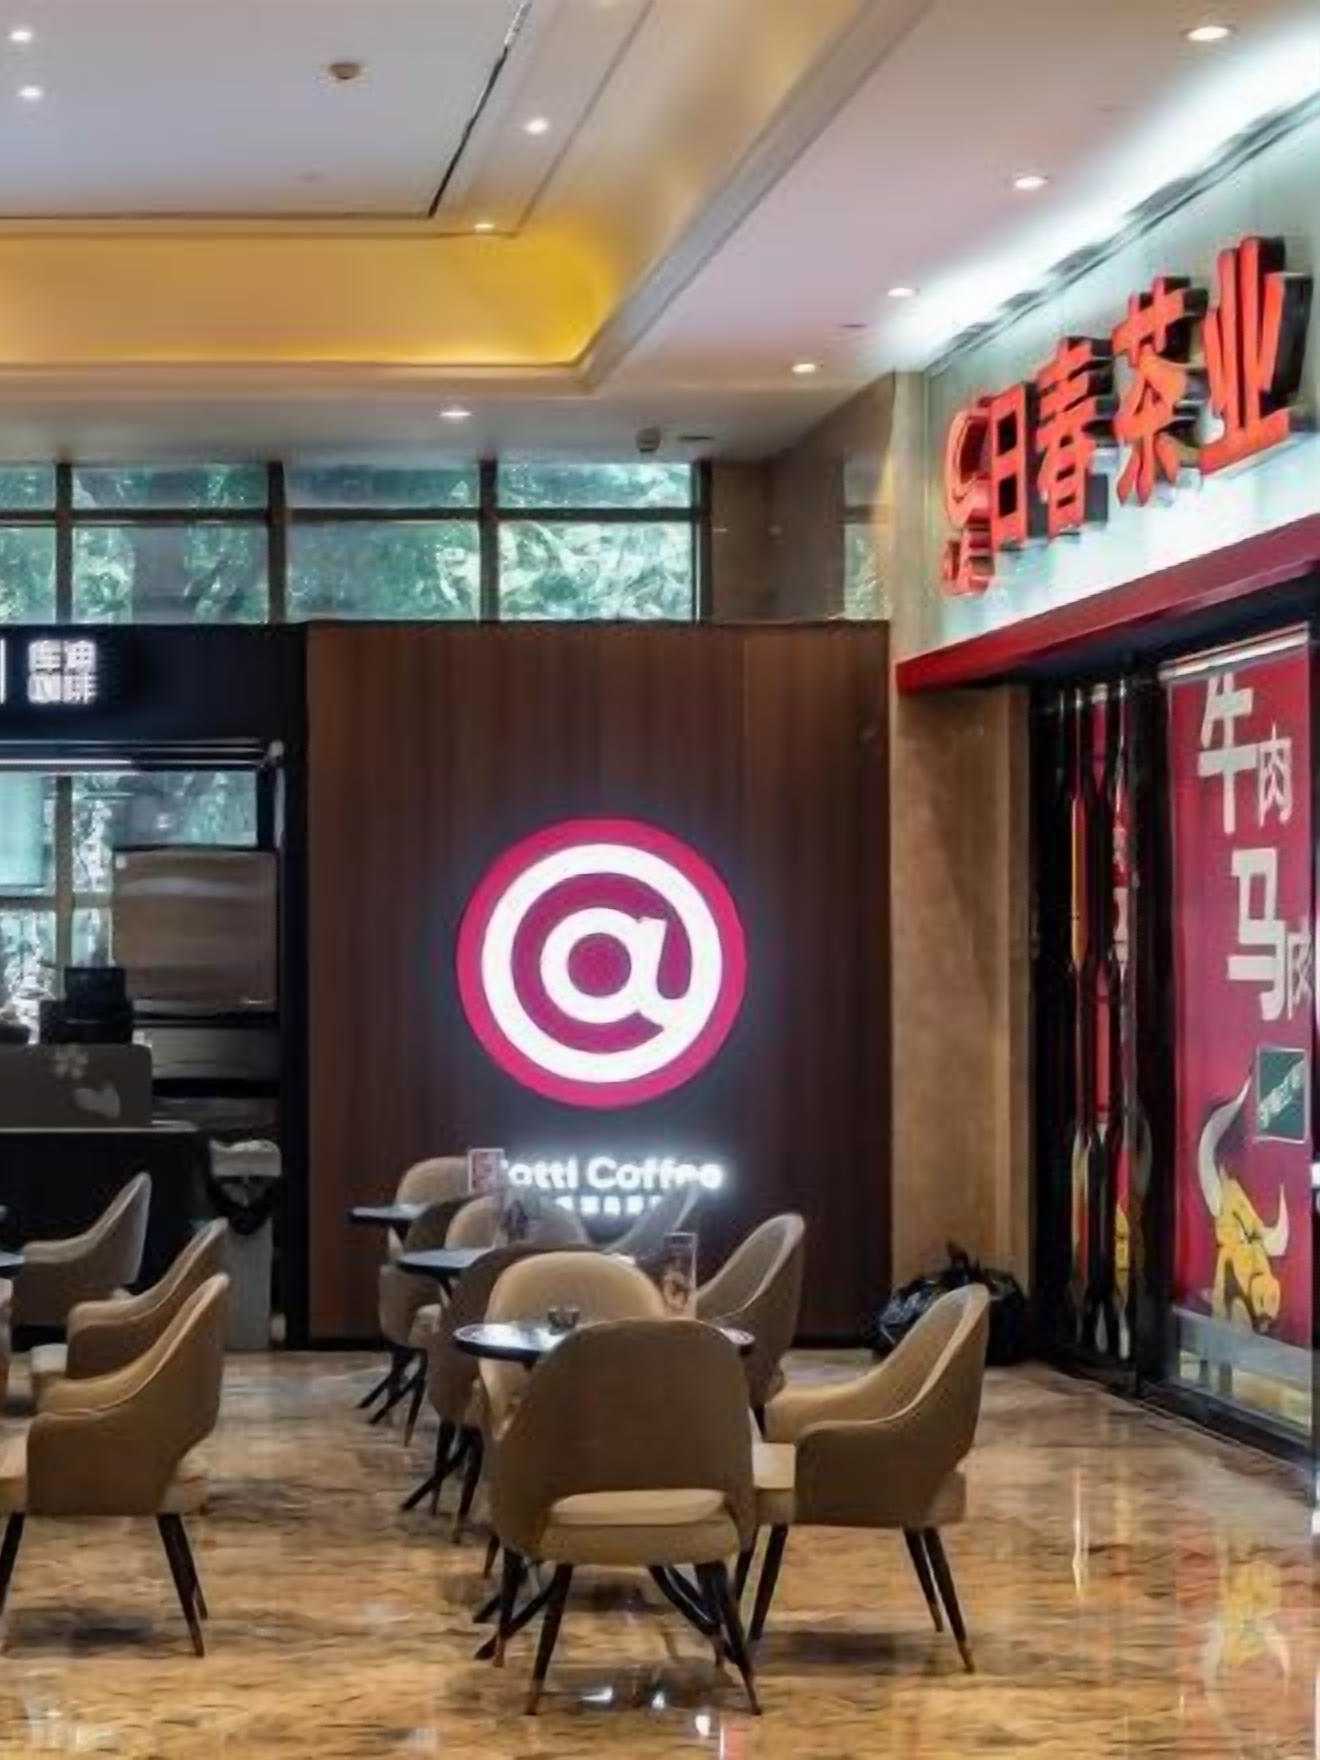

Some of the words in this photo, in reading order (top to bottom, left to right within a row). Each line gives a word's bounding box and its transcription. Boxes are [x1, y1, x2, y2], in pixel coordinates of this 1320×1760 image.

[988, 234, 1292, 550] 日春茶业
[500, 1157, 579, 1188] otti
